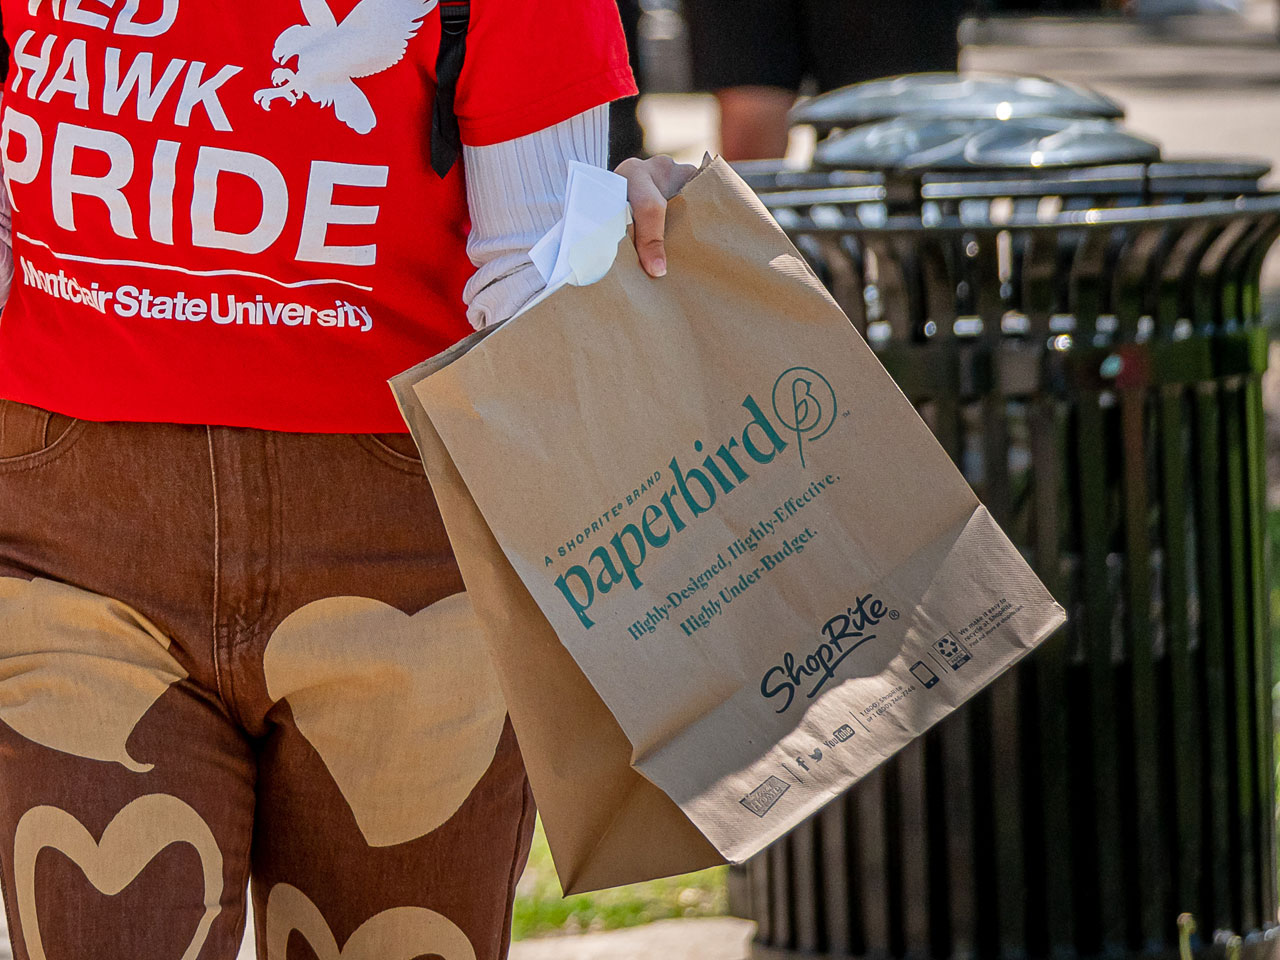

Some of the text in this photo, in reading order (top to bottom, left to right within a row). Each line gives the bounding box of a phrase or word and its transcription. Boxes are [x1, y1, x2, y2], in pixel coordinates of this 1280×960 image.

[12, 30, 243, 131] HAWK
[0, 106, 389, 266] PRIDE
[20, 255, 373, 332] Montclair State University
[544, 556, 553, 567] A
[626, 471, 662, 506] BRAND
[554, 394, 788, 629] paperbird
[627, 473, 841, 640] Highly-Designed, Highly-Effective.
[680, 529, 818, 636] Highly Under-Budget.
[958, 626, 968, 636] We
[823, 724, 855, 749] YouTube
